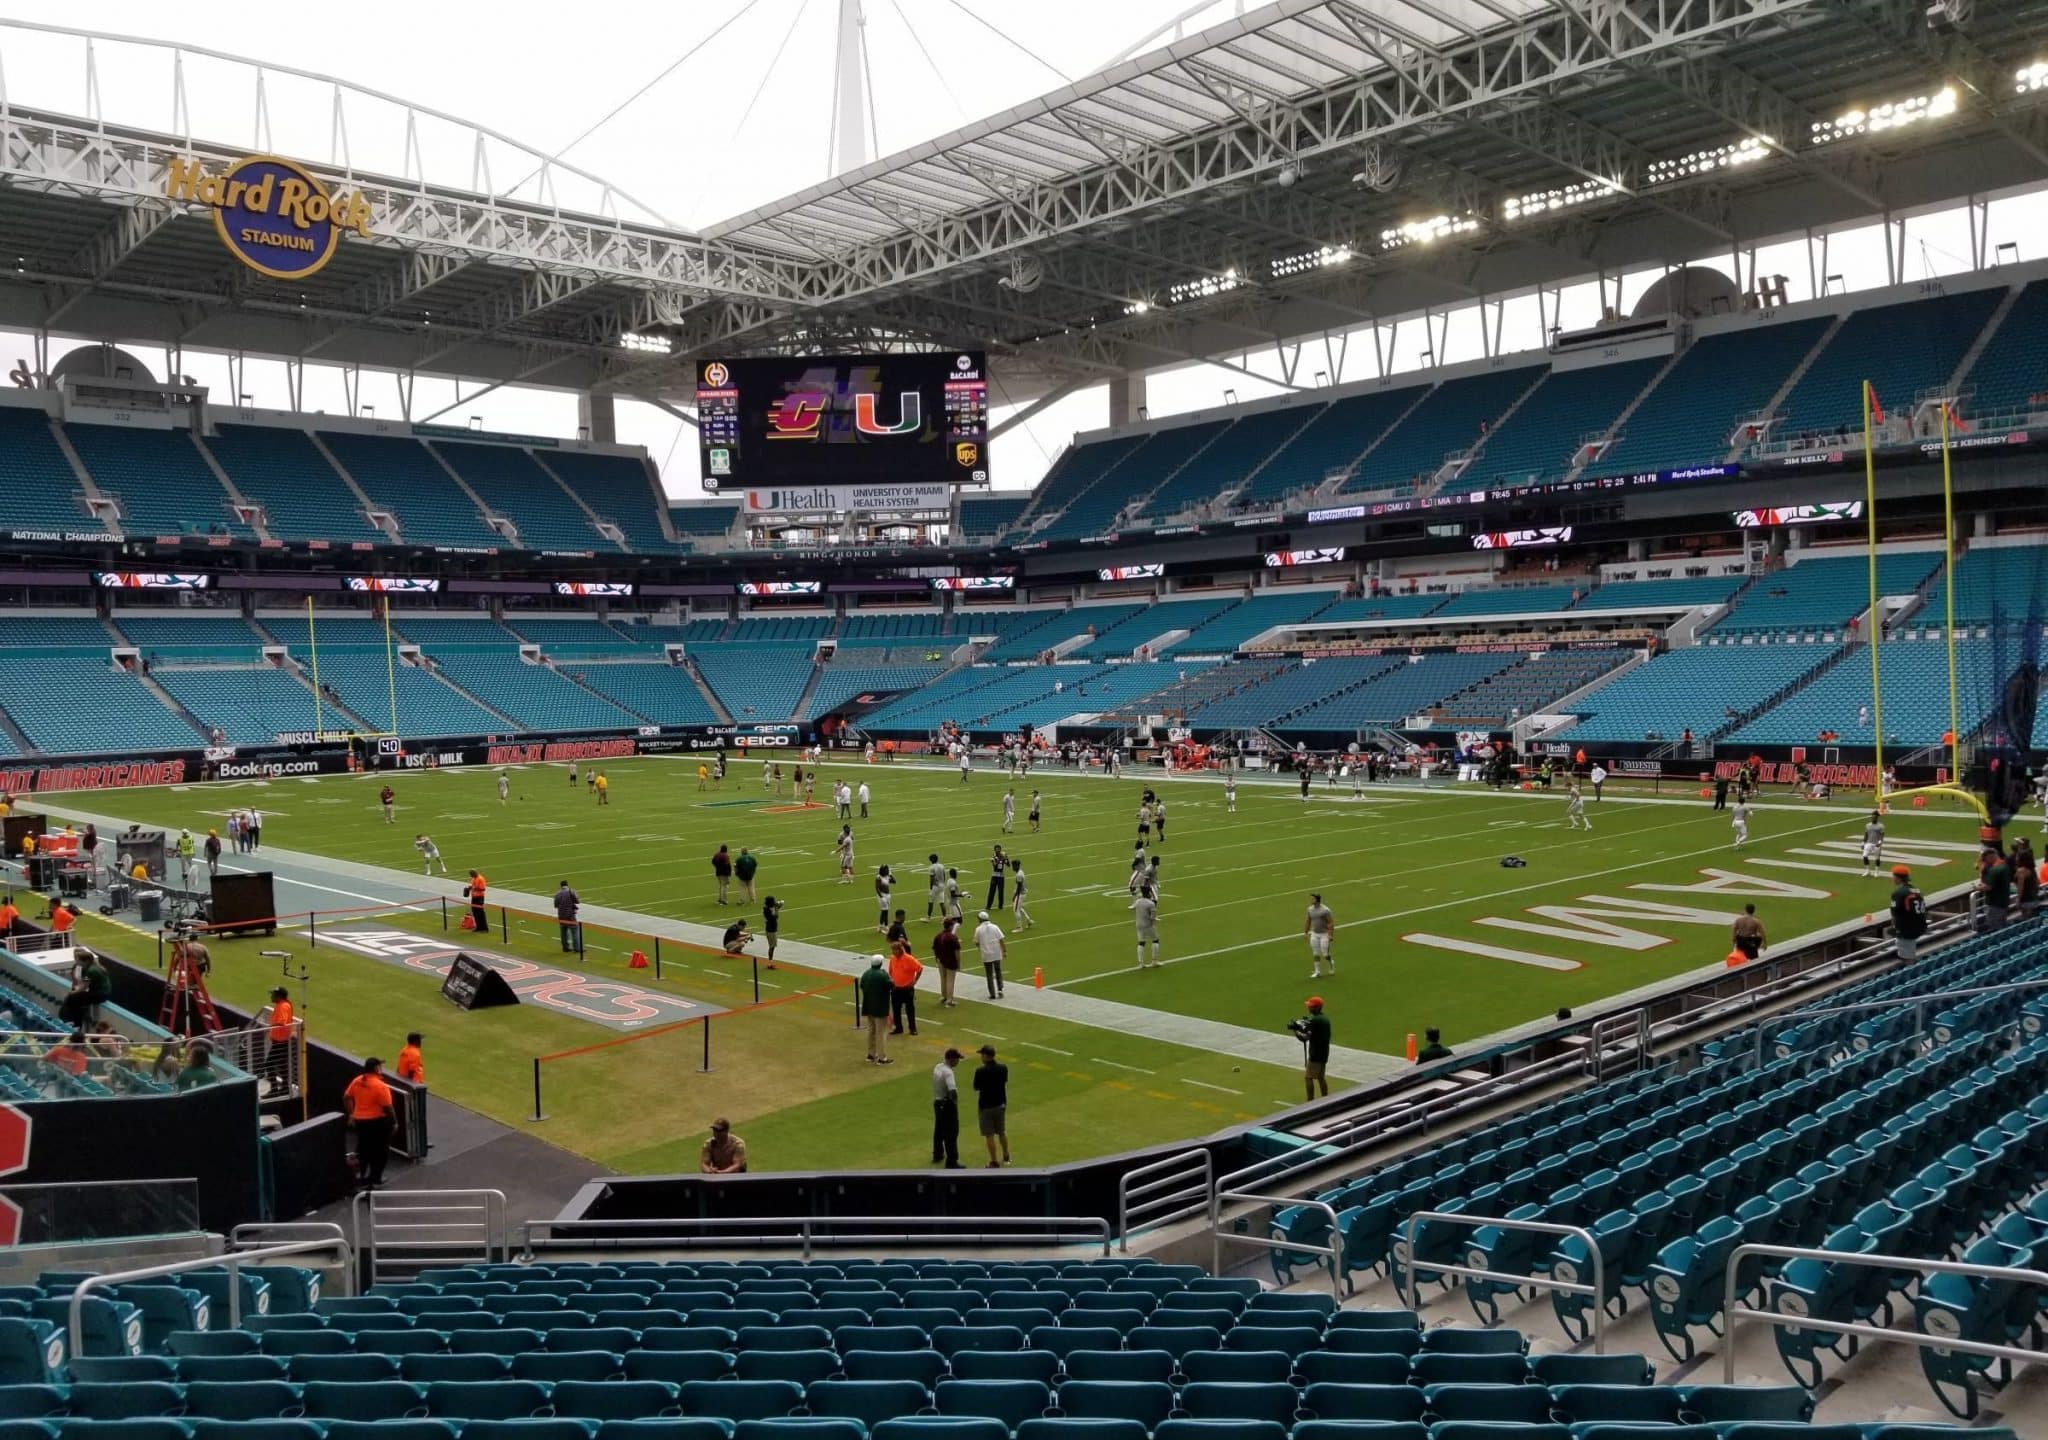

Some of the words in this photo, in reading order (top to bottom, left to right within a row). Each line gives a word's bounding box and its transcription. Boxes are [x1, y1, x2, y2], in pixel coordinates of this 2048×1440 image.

[166, 158, 275, 213] Hard
[278, 178, 375, 239] Rock
[241, 228, 314, 252] STADIUM
[1921, 440, 1957, 451] CORTZ
[1960, 435, 2008, 447] KENNEDY
[960, 450, 976, 463] ups
[1784, 456, 1799, 464] JIM
[1801, 455, 1827, 463] KELLY
[853, 487, 901, 497] UNIVERSITY
[903, 487, 914, 496] OF
[915, 486, 943, 495] MIAMI
[853, 499, 884, 507] HEALTH
[886, 498, 919, 506] SYSTEM
[1388, 504, 1403, 512] CMU
[12, 531, 61, 541] NATIONAL
[65, 532, 125, 543] CHAMPIONS
[754, 725, 798, 734] GEICO
[277, 732, 322, 745] MUSCLE
[323, 731, 349, 743] MILK
[734, 736, 789, 746] GEICO
[381, 740, 398, 752] 40
[544, 737, 636, 761] HURRICANES
[439, 752, 464, 765] MILK
[36, 758, 185, 792] HURRICANES
[220, 761, 319, 777] Bookng.com
[1714, 761, 1776, 782] MII
